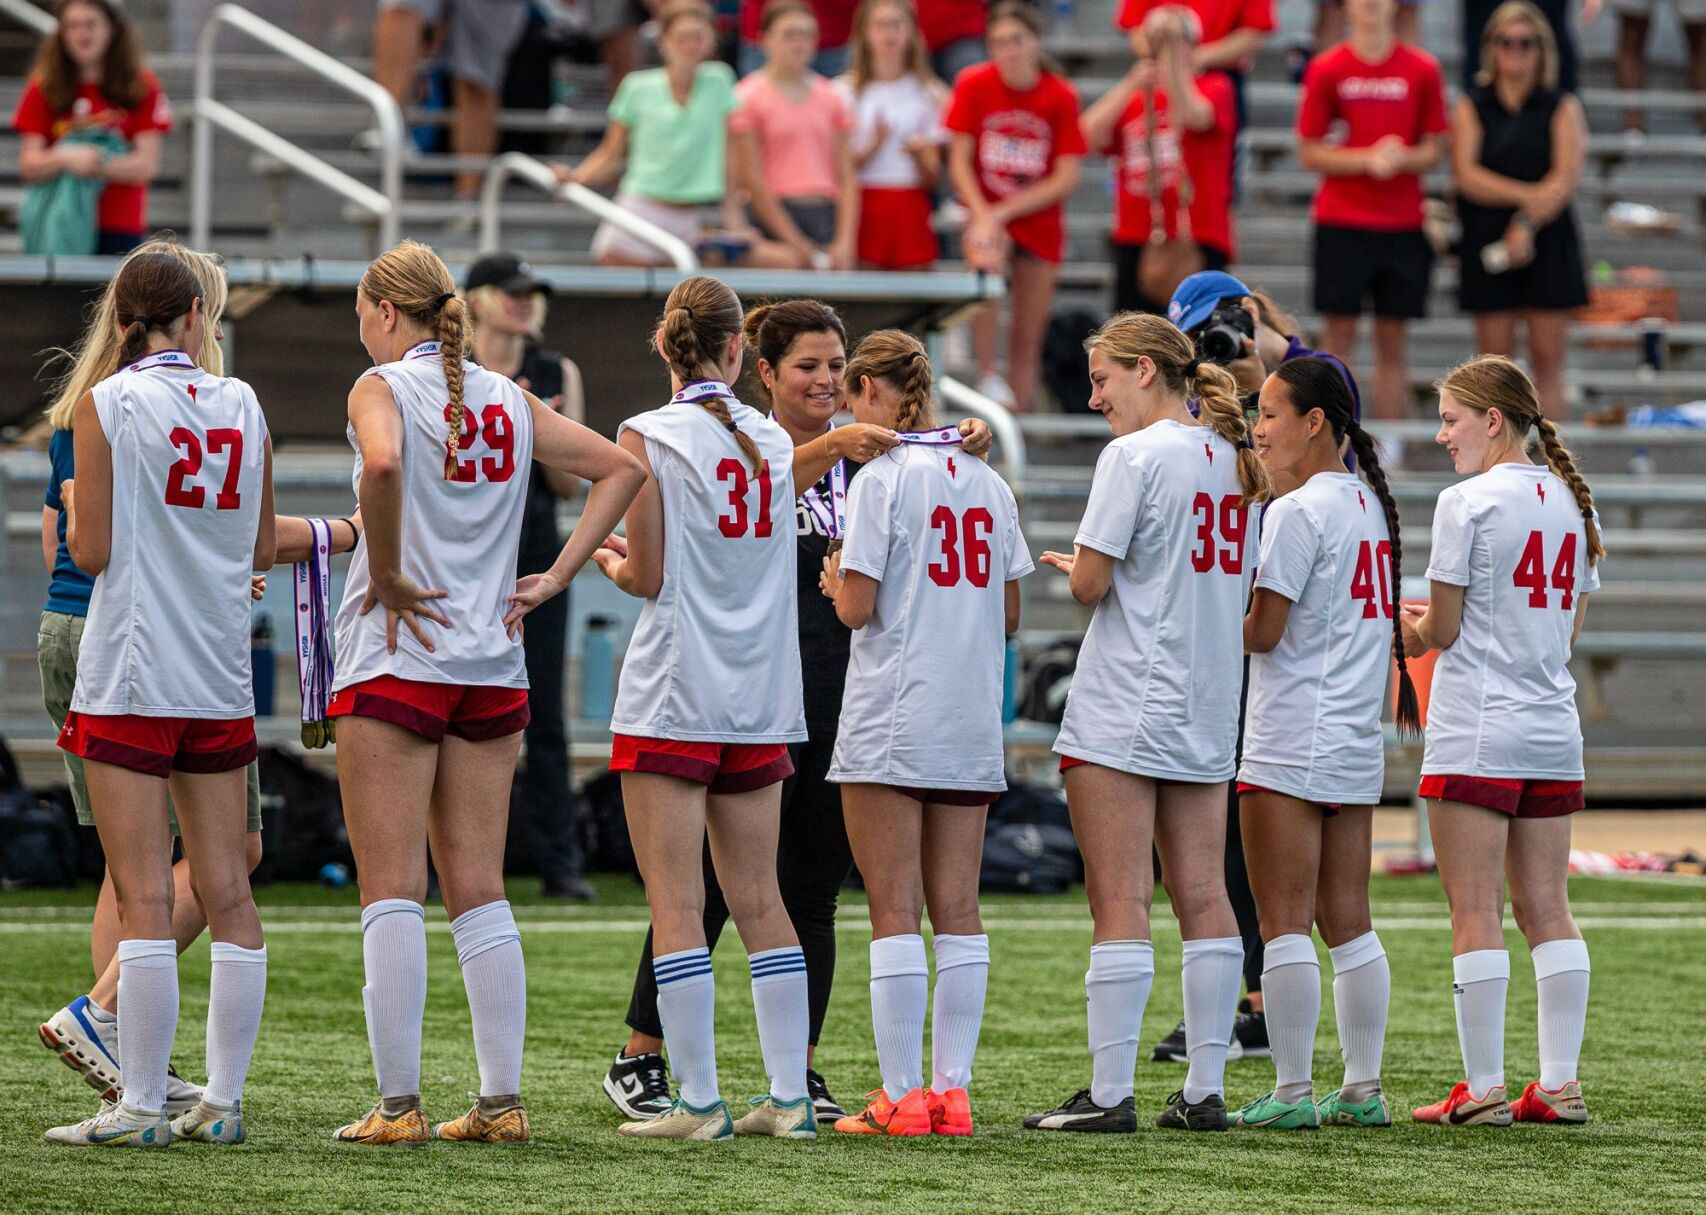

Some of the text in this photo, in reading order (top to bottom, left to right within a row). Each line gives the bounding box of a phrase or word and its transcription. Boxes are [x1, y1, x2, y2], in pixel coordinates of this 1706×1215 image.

[165, 427, 243, 509] 27
[443, 403, 515, 483] 29
[716, 457, 773, 538] 31
[1191, 491, 1249, 575] 39
[928, 505, 994, 588] 36
[1350, 539, 1394, 620] 40
[1513, 530, 1577, 610] 44
